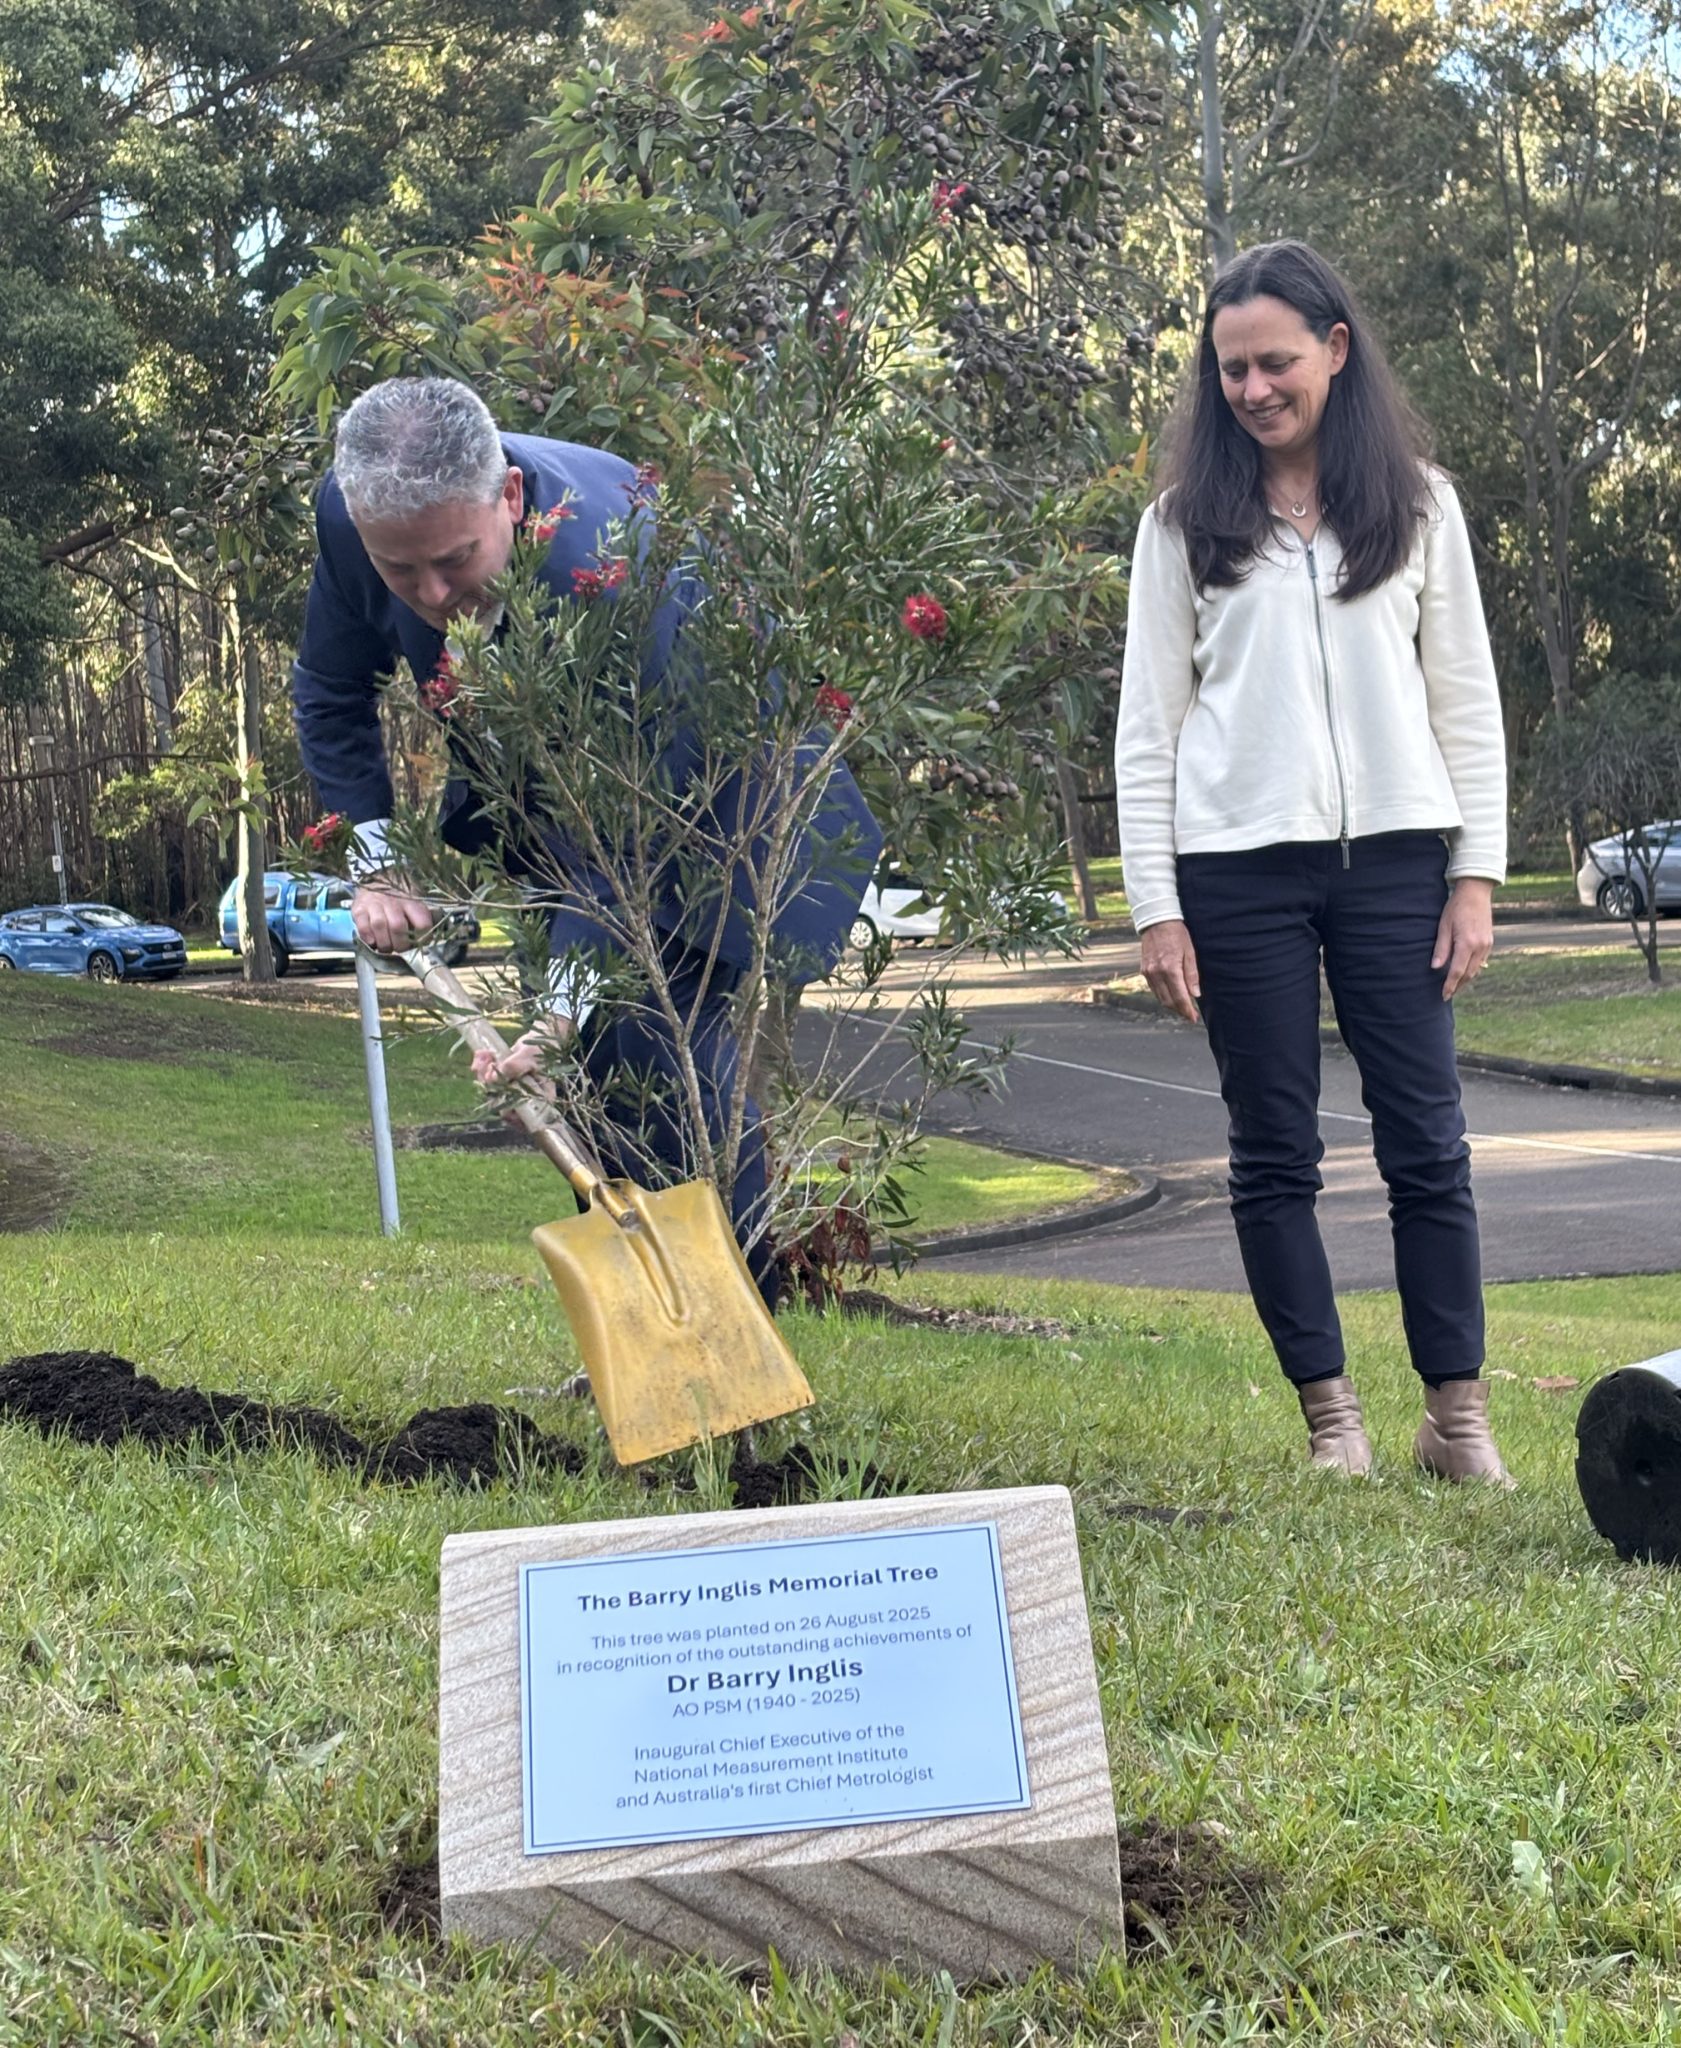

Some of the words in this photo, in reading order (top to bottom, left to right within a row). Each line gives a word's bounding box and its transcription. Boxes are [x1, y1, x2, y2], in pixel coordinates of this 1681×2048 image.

[577, 1594, 622, 1612] The
[628, 1588, 692, 1608] Barry
[697, 1579, 763, 1603] Inglis
[768, 1567, 884, 1595] Memorial
[886, 1566, 939, 1584] Tree
[591, 1635, 626, 1650] This
[630, 1633, 663, 1646] tree
[666, 1629, 702, 1643] was
[706, 1620, 770, 1643] planted
[774, 1620, 796, 1633] on
[800, 1615, 822, 1631] 26
[825, 1611, 884, 1629] August
[887, 1606, 931, 1623] 2025
[557, 1663, 572, 1675] in
[577, 1653, 672, 1673] recognition
[676, 1648, 692, 1664] of
[696, 1647, 724, 1662] the
[728, 1637, 830, 1659] outstanding
[833, 1627, 952, 1649] achievements
[955, 1623, 972, 1639] of
[667, 1674, 700, 1694] Dr
[707, 1668, 781, 1692] Barry
[788, 1657, 864, 1685] Inglis
[672, 1702, 700, 1718] AO
[704, 1698, 742, 1716] PSM
[746, 1693, 796, 1714] (1940
[811, 1687, 861, 1706] 2025)
[634, 1740, 716, 1761] Inaugural
[719, 1735, 765, 1754] Chief
[770, 1729, 852, 1749] Executive
[855, 1725, 872, 1741] of
[876, 1723, 905, 1739] the
[634, 1763, 709, 1784] National
[713, 1753, 833, 1777] Measurement
[837, 1746, 908, 1765] Institute
[616, 1791, 649, 1809] and
[653, 1783, 744, 1806] Australia's
[748, 1781, 781, 1796] first
[785, 1775, 832, 1793] Chief
[836, 1767, 934, 1788] Metrologist
